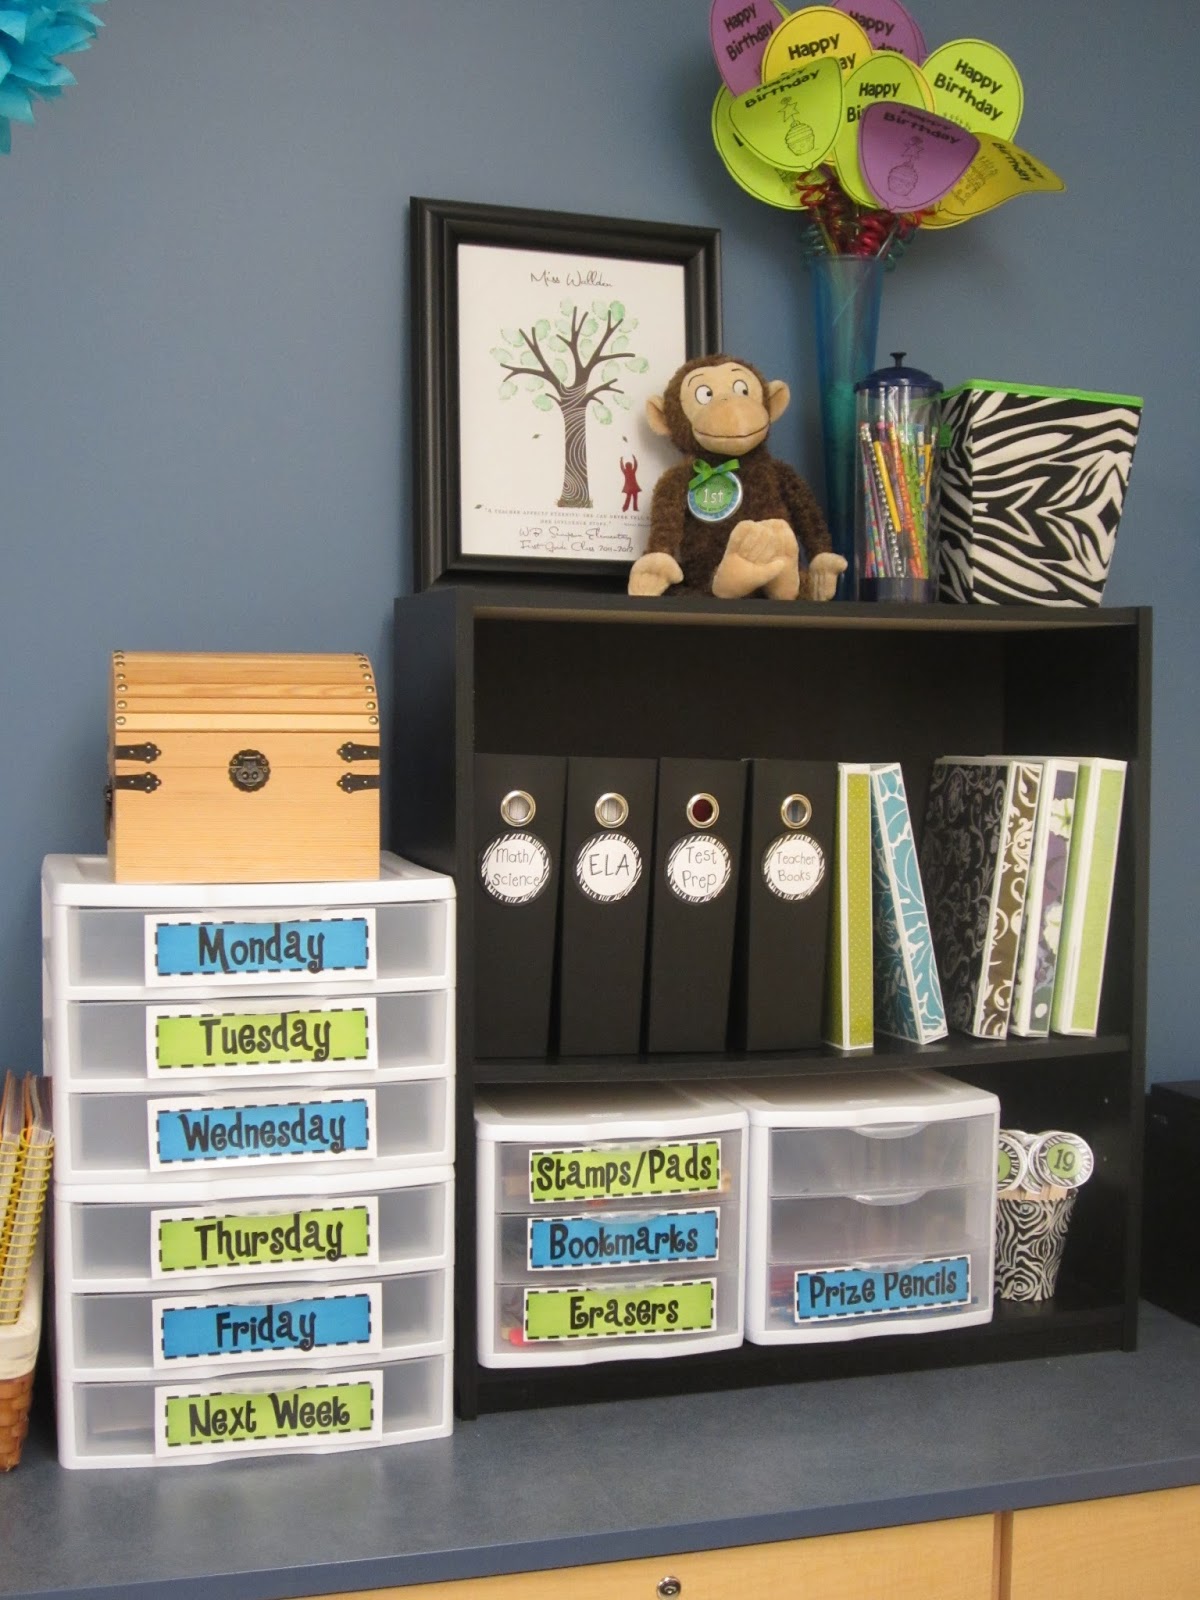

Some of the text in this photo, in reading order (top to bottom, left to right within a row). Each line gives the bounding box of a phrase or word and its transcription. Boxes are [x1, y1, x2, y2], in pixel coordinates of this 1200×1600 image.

[723, 3, 757, 32] Happy
[725, 20, 774, 61] Birthday
[788, 33, 840, 60] Happy
[745, 69, 820, 108] Birthday
[859, 82, 901, 98] Happy
[955, 58, 1003, 95] Happy
[934, 72, 1004, 122] Birthday
[883, 111, 960, 144] Birthday
[530, 269, 560, 287] Miss
[703, 488, 724, 503] 1st
[589, 853, 630, 877] ELA
[685, 846, 717, 865] Test
[776, 851, 816, 866] Teacher
[491, 873, 540, 888] Science
[681, 869, 717, 893] Prep
[777, 869, 811, 882] Books
[199, 923, 325, 974] Monday
[199, 1013, 331, 1062] Tuesday
[177, 1108, 346, 1154] Wednesday
[536, 1146, 712, 1193] Stamps/Pads
[1053, 1149, 1076, 1172] 19
[194, 1213, 344, 1262] Thursday
[549, 1224, 698, 1260] Bookmarks
[809, 1266, 957, 1308] Prize Pencils
[216, 1304, 316, 1351] Friday
[570, 1296, 679, 1330] Erasers
[189, 1392, 350, 1437] Next Week
